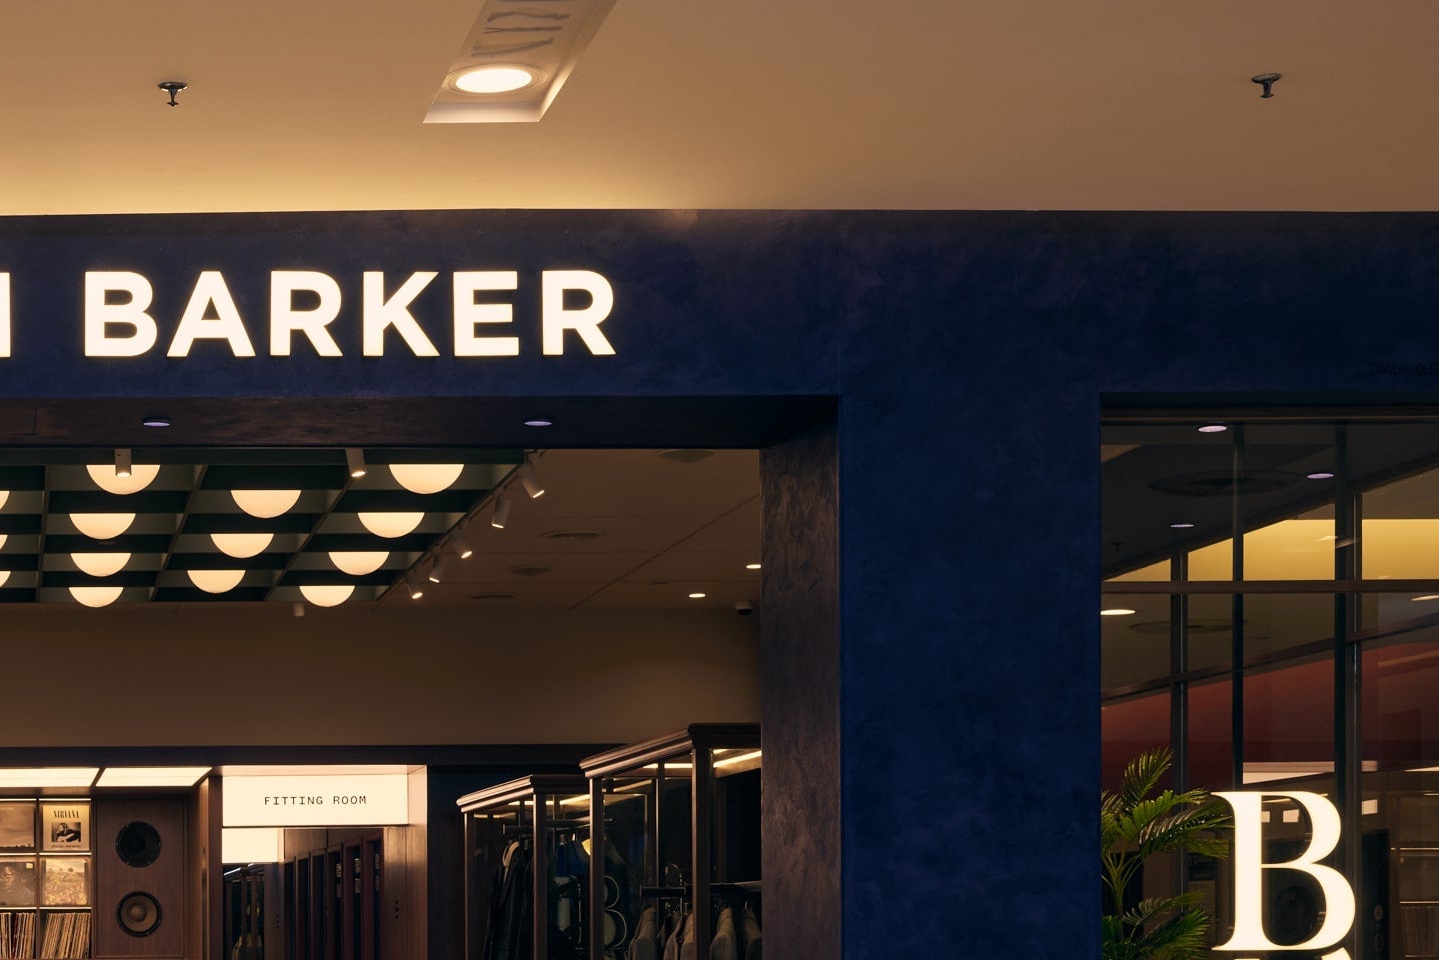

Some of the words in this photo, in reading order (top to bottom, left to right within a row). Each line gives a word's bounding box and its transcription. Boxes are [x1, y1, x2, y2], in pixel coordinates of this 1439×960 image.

[84, 270, 616, 357] BARKER
[264, 796, 323, 805] FITTING
[333, 795, 367, 805] ROOM
[53, 810, 80, 819] NIRVANA
